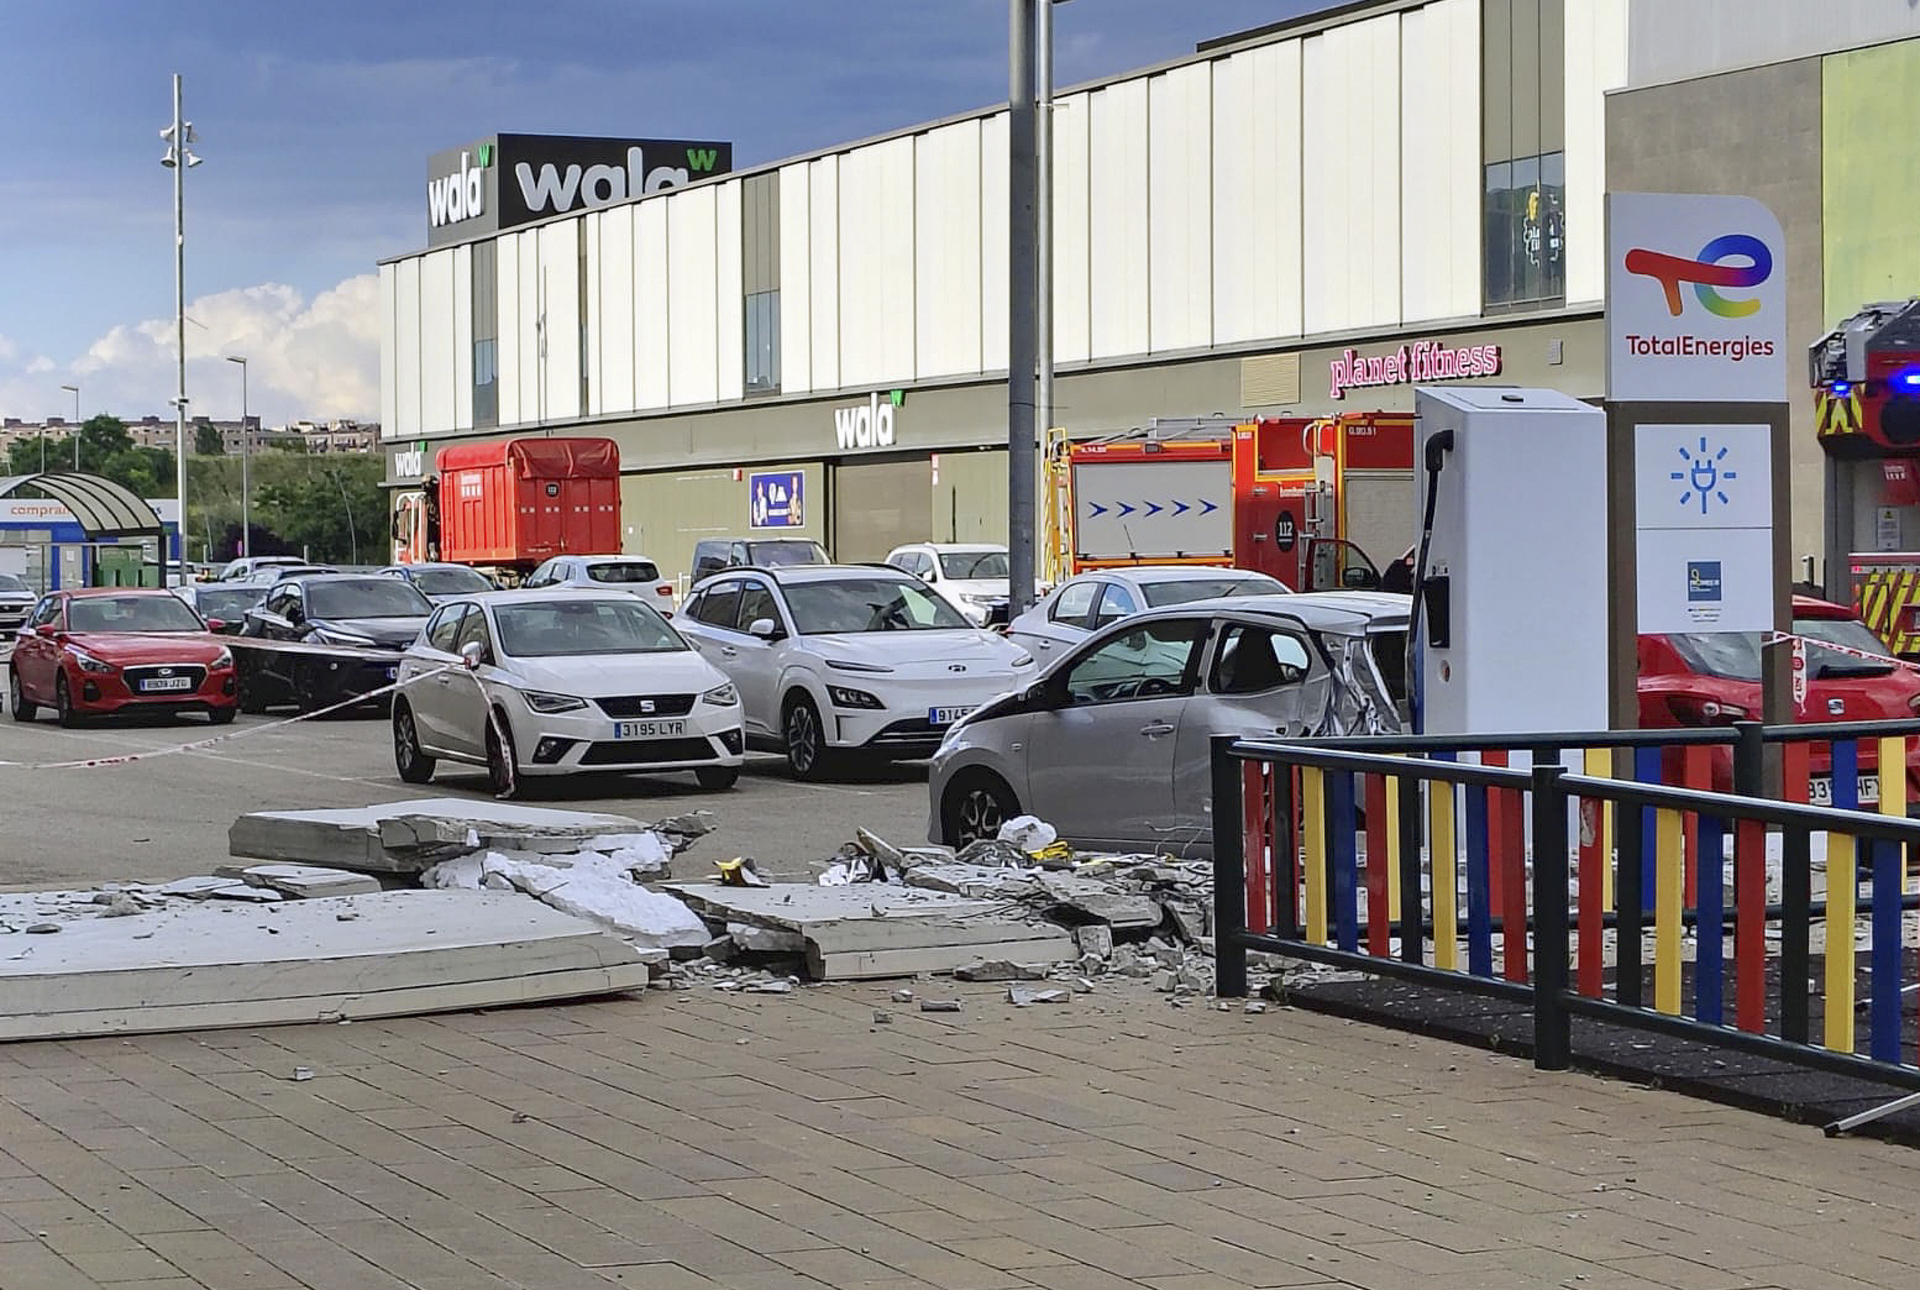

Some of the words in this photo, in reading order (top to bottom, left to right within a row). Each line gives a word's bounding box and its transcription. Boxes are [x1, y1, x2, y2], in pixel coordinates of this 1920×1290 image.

[429, 152, 483, 227] wala
[1626, 336, 1774, 361] TotalEnergies
[1330, 348, 1408, 398] planet
[1411, 341, 1499, 380] fitness
[834, 392, 894, 449] wala
[395, 442, 421, 477] wala
[1278, 521, 1293, 536] 112
[622, 724, 655, 736] 3195
[660, 722, 683, 735] LYR
